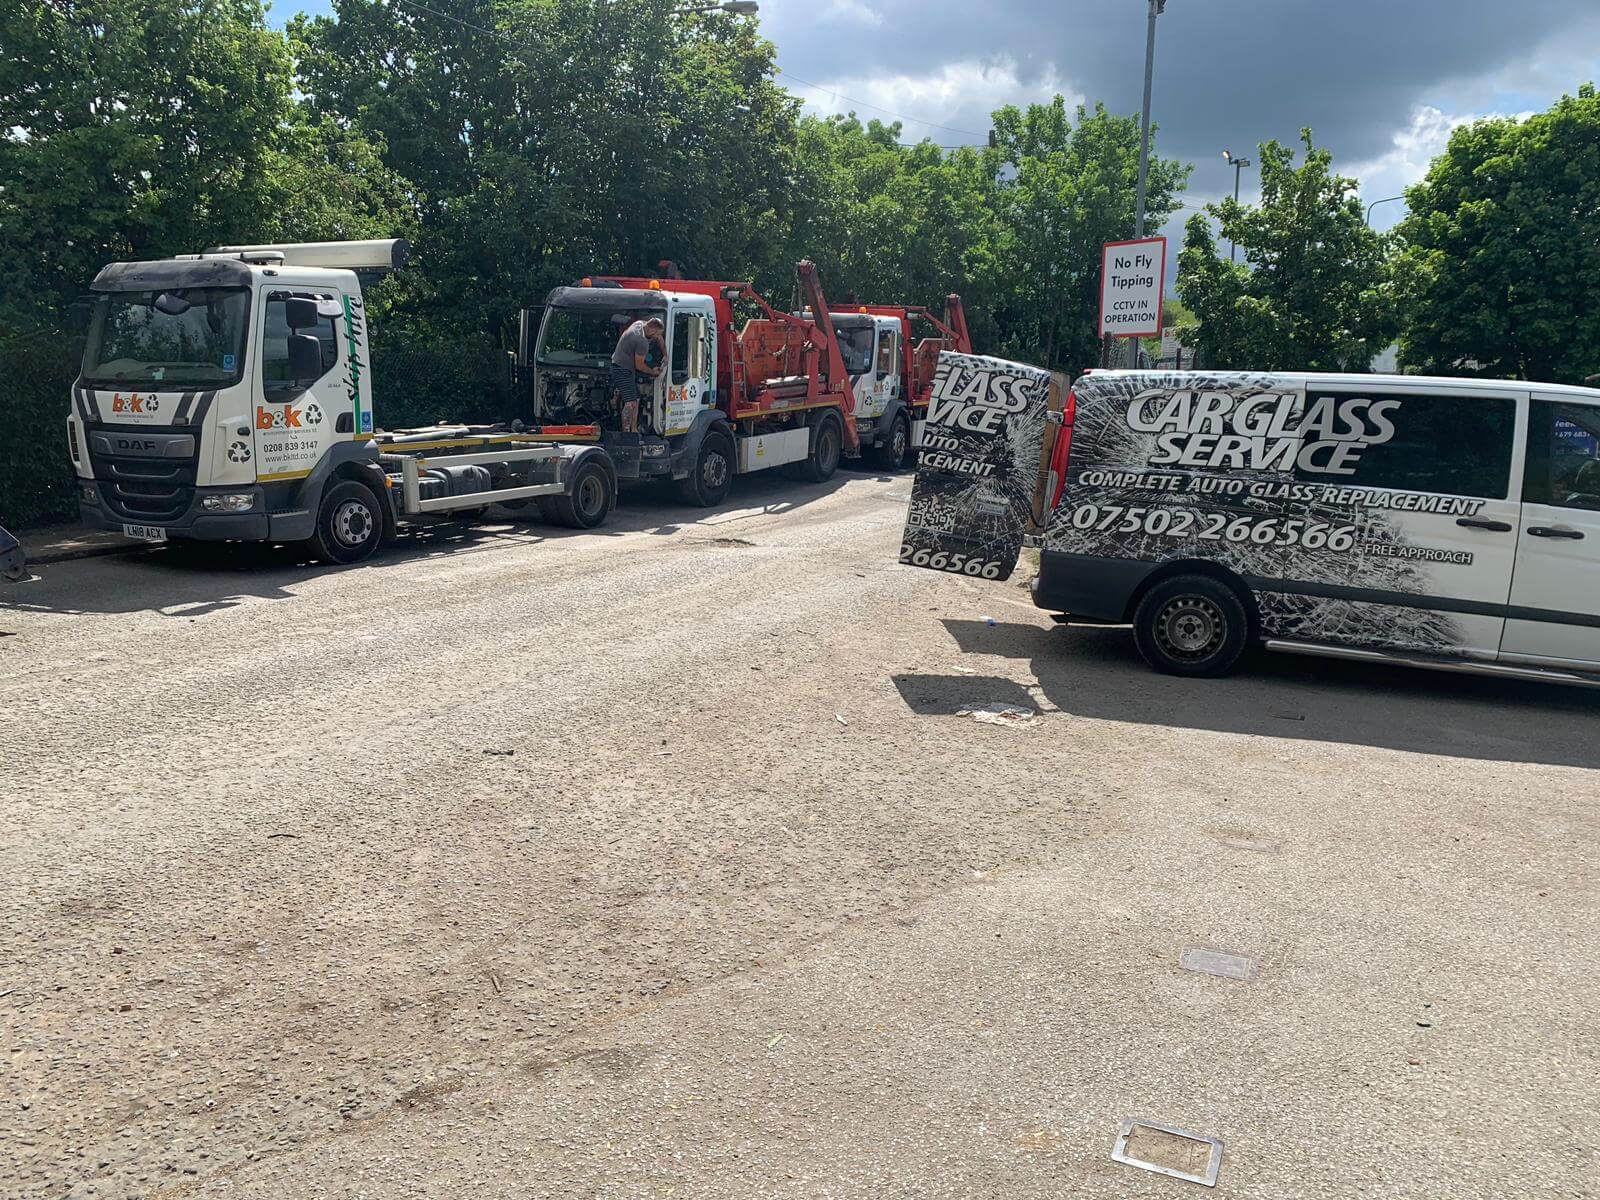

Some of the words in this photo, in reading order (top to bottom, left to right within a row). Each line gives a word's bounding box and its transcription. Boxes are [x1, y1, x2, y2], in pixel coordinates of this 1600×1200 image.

[1115, 257, 1131, 270] No
[1135, 254, 1153, 269] Fly
[1111, 274, 1154, 290] Tipping
[1113, 301, 1136, 311] CCTV
[1138, 300, 1149, 310] IN
[1104, 312, 1156, 324] OPERATION
[112, 393, 145, 413] b&k
[255, 404, 303, 430] b&k
[1126, 387, 1402, 445] CARGLASS
[117, 439, 156, 450] DAF
[263, 443, 283, 453] 0208
[284, 442, 299, 451] 839
[300, 440, 318, 450] 3147
[1148, 431, 1369, 475] SERVICE
[265, 451, 318, 463] www.bkltd.co.uk
[1078, 471, 1183, 491] COMPLETE
[1185, 476, 1244, 496] AUTO
[1249, 481, 1316, 501] GLASS
[1320, 486, 1485, 516] REPLACEMENT
[146, 526, 162, 539] ACX
[1071, 503, 1196, 538] 07502
[1198, 512, 1356, 552] 266566
[900, 544, 1002, 579] 266566
[1364, 543, 1397, 558] FREE
[1397, 546, 1473, 565] APPROACH
